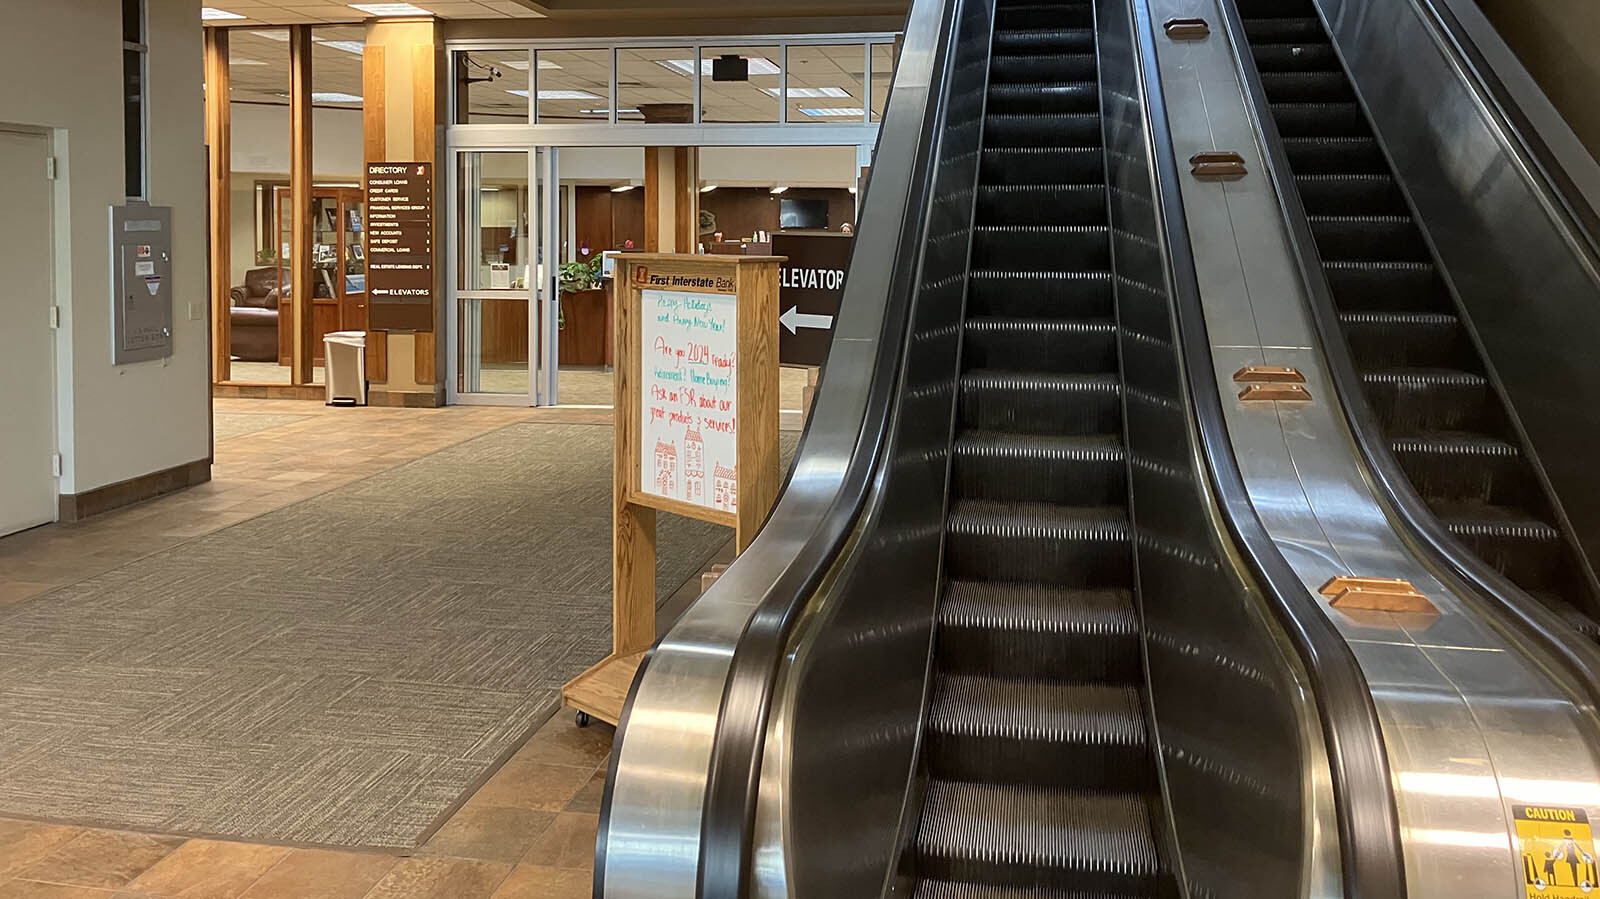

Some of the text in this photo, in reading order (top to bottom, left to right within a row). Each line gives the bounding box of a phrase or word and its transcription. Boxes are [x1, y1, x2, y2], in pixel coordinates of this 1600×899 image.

[650, 274, 734, 288] First Interstate Bank
[694, 316, 708, 328] New
[655, 336, 736, 376] Are you 2024 ready?
[651, 384, 732, 411] Ask an FSR about our
[650, 406, 664, 424] great
[669, 410, 693, 427] products
[704, 418, 735, 434] services!
[1525, 807, 1576, 821] CAUTION
